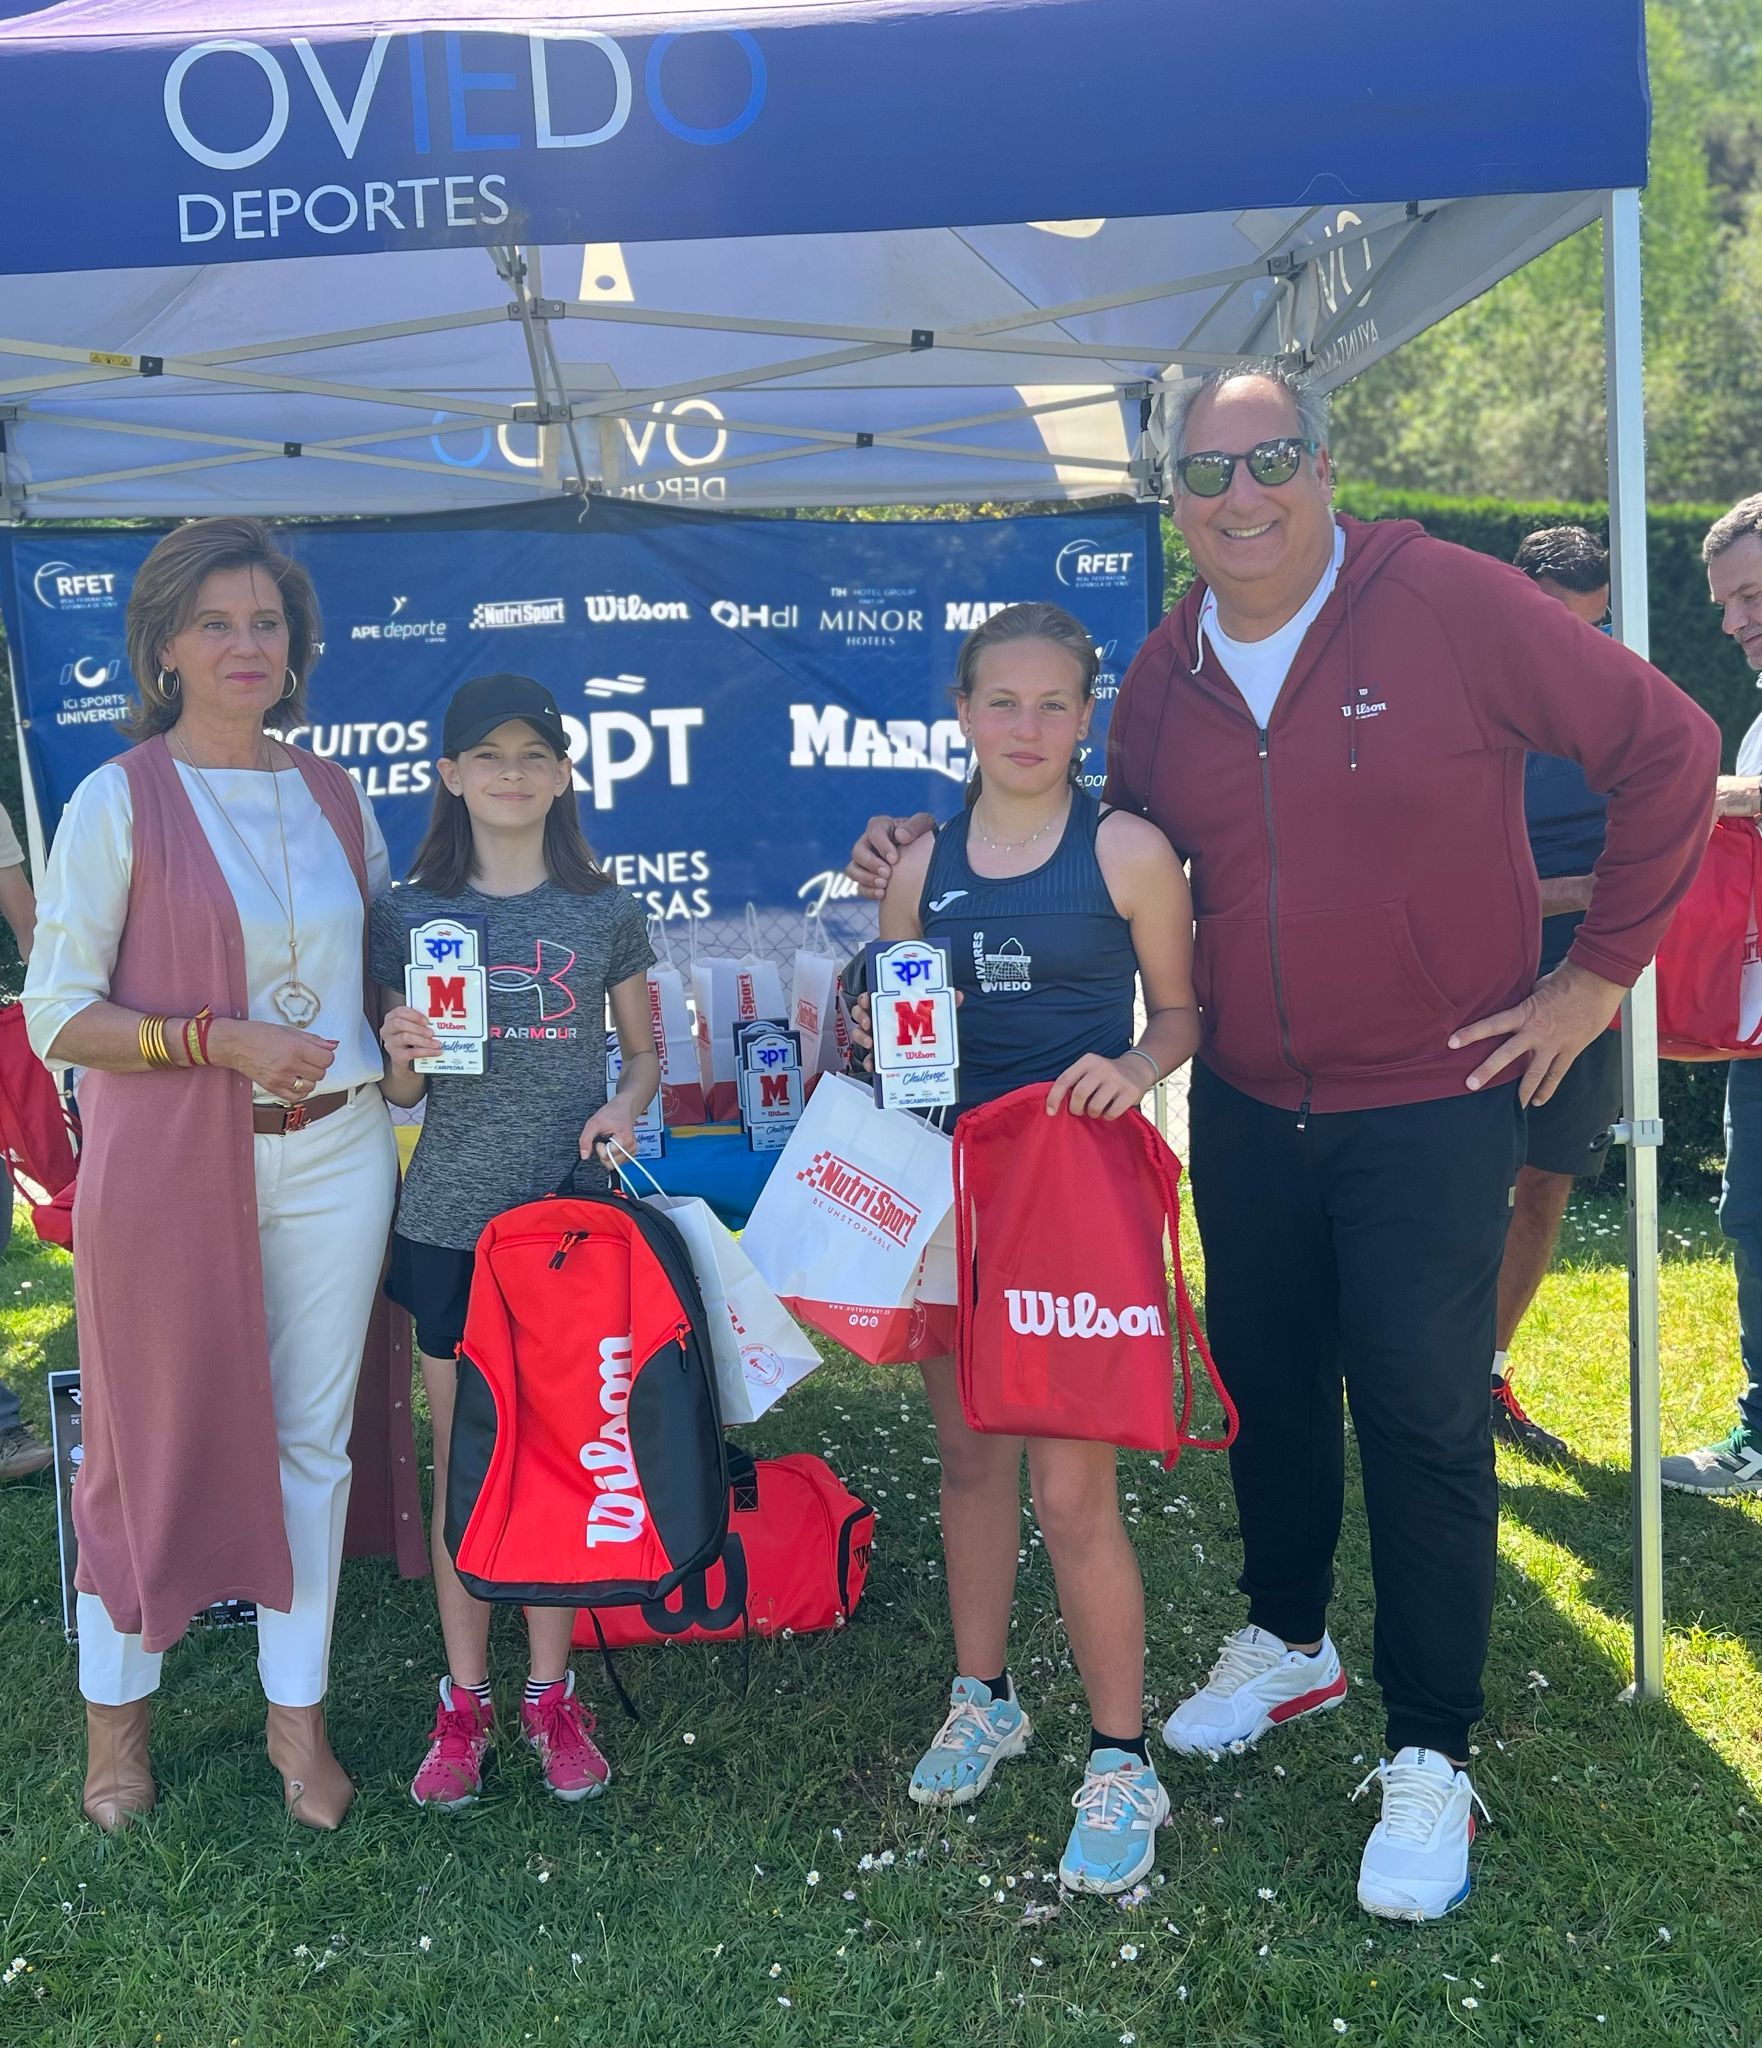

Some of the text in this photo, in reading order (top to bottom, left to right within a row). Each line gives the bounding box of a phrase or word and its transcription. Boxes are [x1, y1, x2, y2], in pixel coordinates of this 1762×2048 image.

[164, 26, 767, 170] OVIEDO
[178, 174, 509, 243] DEPORTES
[1076, 553, 1133, 574] RFET
[56, 574, 115, 596] RFET
[853, 588, 882, 596] HOTEL
[883, 588, 917, 596] GROUP
[483, 601, 565, 625] NutriSport
[584, 594, 689, 622] Wilson
[351, 619, 447, 641] APE deporte
[819, 610, 924, 631] MINOR
[846, 636, 895, 646] HOTELS
[63, 694, 126, 709] ICI SPORTS
[56, 707, 130, 725] UNIVERSIT
[789, 704, 978, 783] MARC
[424, 939, 464, 962] RPT
[891, 960, 933, 986] RPT
[427, 976, 466, 1018] M
[436, 1022, 466, 1030] Wilson
[504, 1027, 577, 1039] ARMOUR
[894, 1000, 936, 1045] M
[440, 1040, 476, 1054] hallenge
[757, 1048, 788, 1068] RPT
[904, 1051, 936, 1060] Wilson
[902, 1069, 946, 1086] Challenge
[760, 1074, 790, 1107] M
[818, 1159, 918, 1243] NutriSport
[812, 1197, 893, 1252] BE UNSTOPPABLE
[1004, 1289, 1166, 1339] Wilson
[579, 1333, 645, 1548] Wilson
